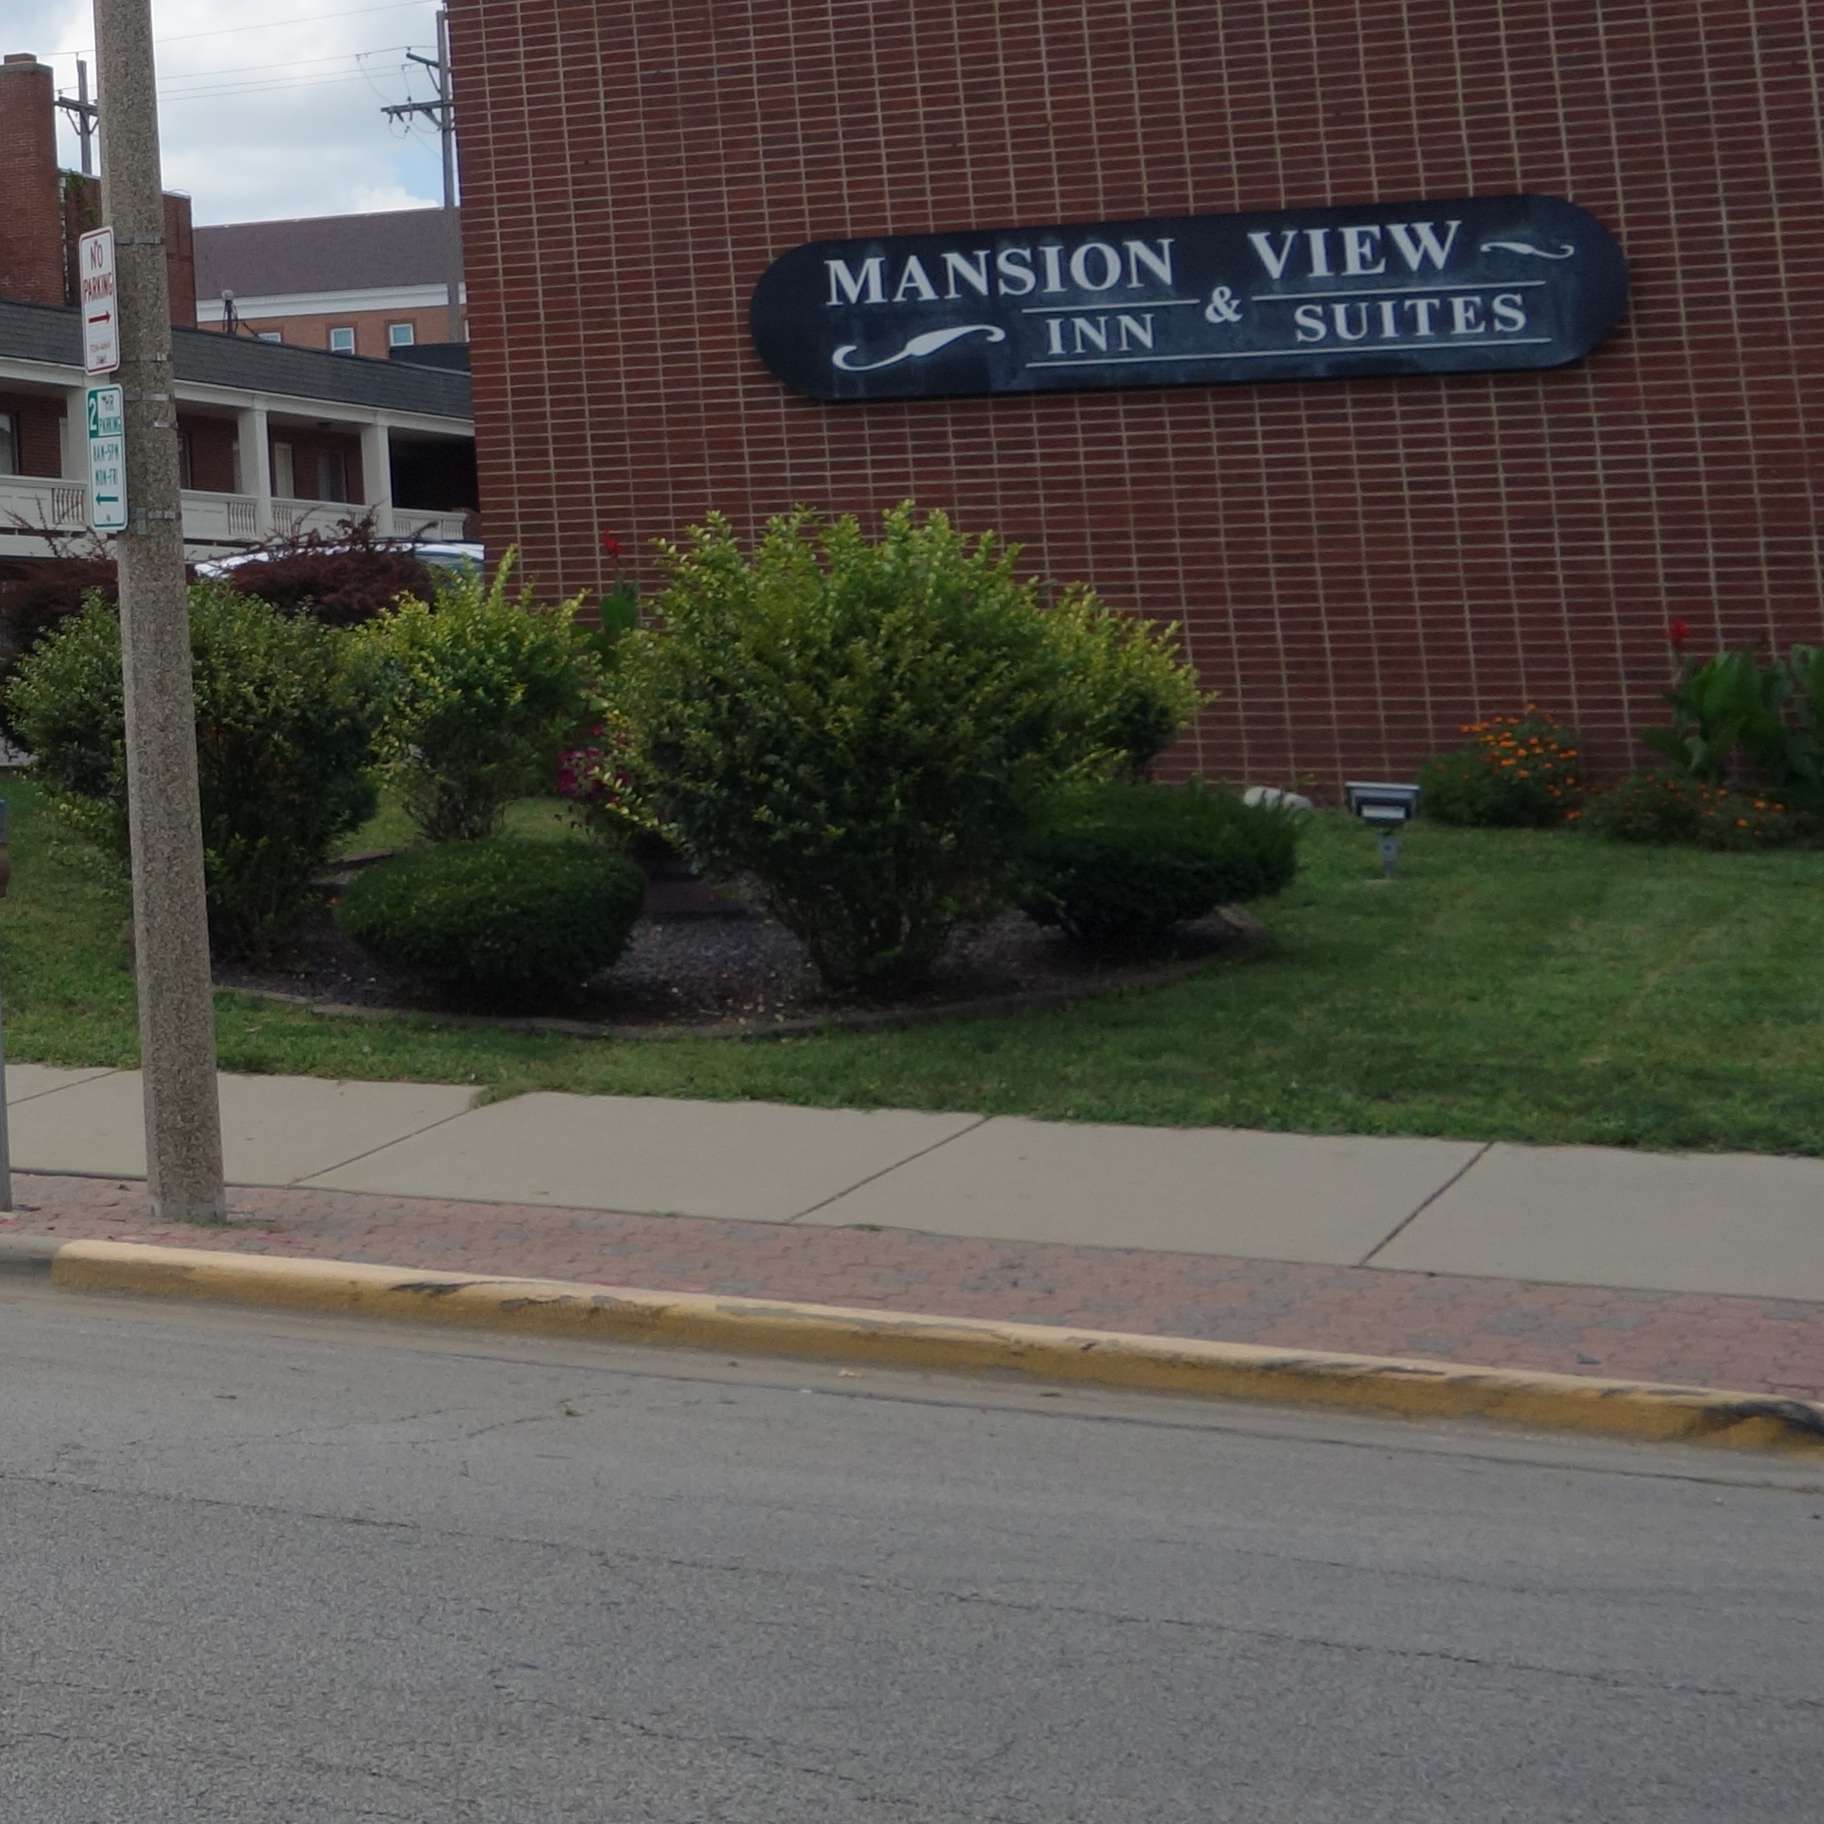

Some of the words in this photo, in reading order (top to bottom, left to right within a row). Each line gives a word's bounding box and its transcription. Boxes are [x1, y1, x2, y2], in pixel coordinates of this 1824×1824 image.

[90, 240, 103, 271] NO
[824, 238, 1175, 306] MANSION
[1248, 220, 1462, 279] VIEW
[83, 272, 113, 303] PARKING
[1046, 313, 1155, 355] INN
[1204, 285, 1243, 324] &
[1294, 292, 1528, 343] SUITES
[89, 397, 98, 431] 2
[99, 416, 121, 433] PARKING
